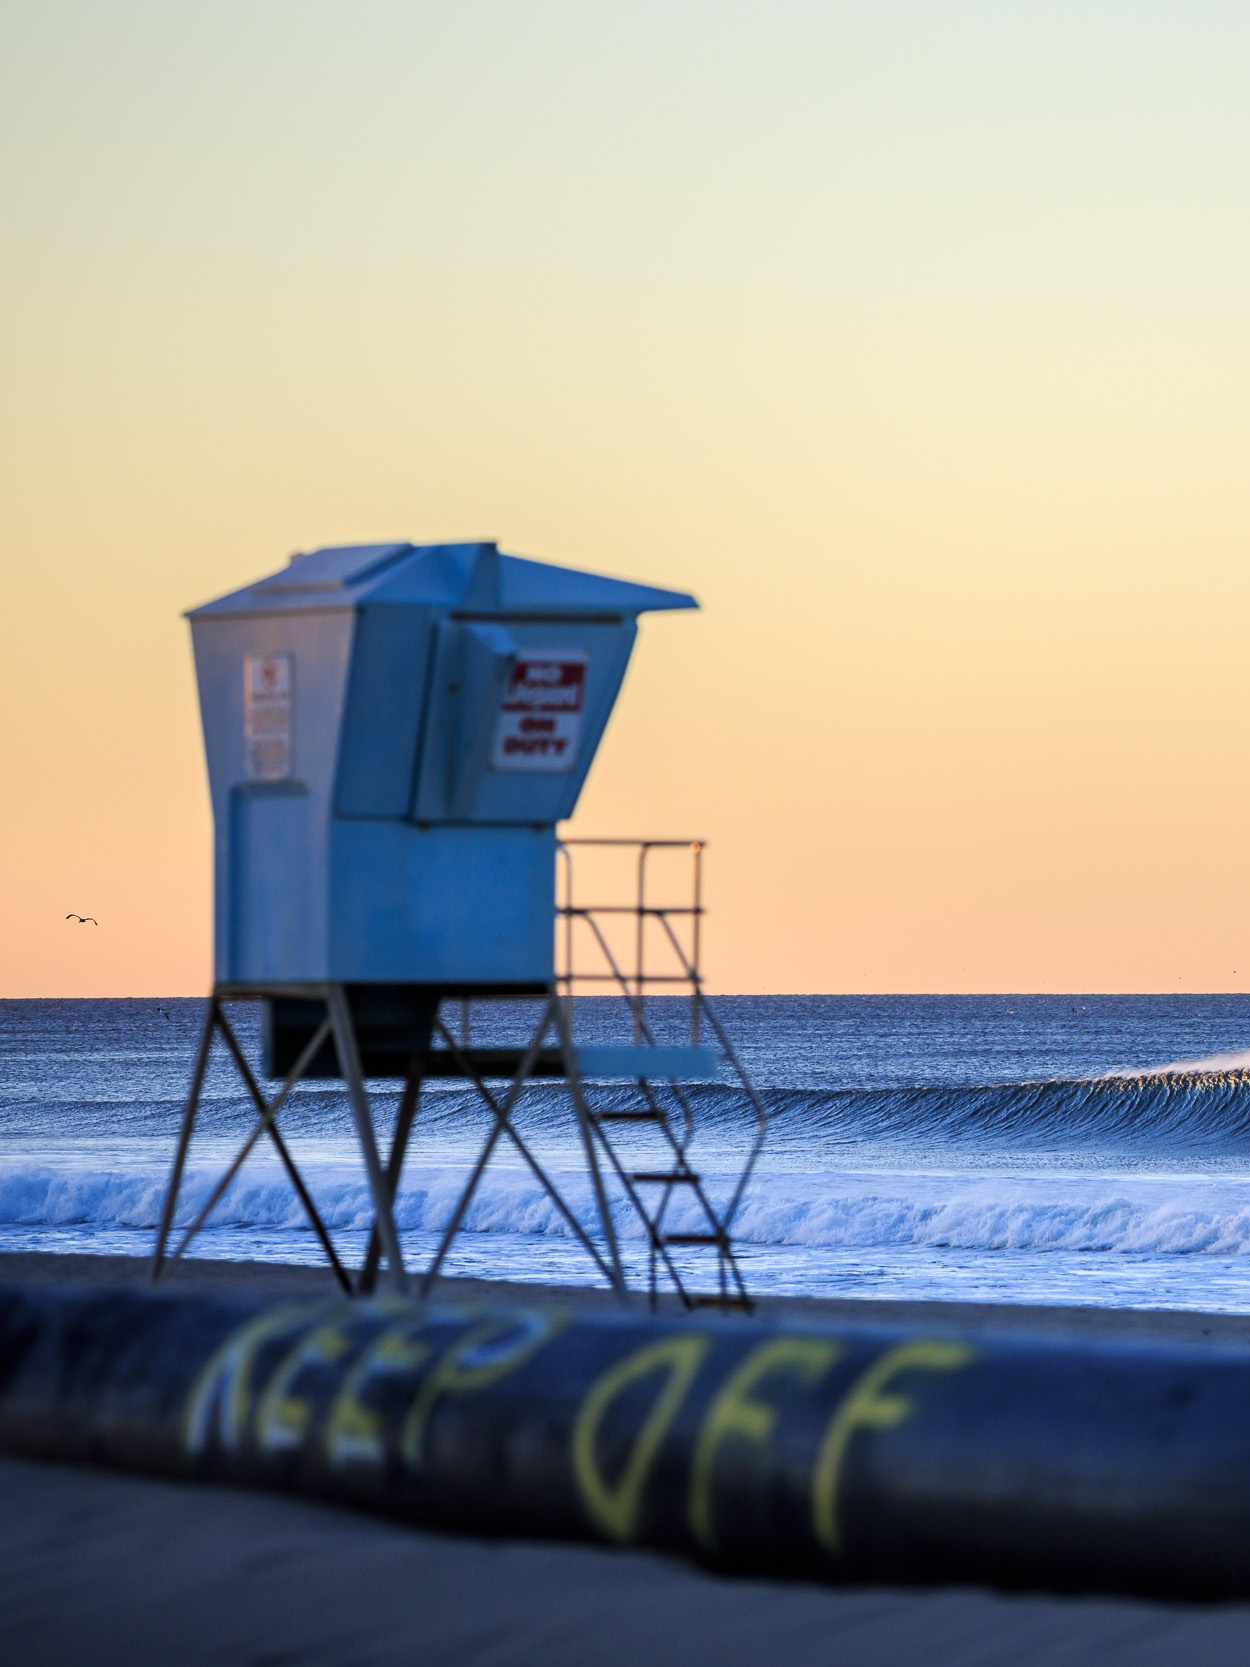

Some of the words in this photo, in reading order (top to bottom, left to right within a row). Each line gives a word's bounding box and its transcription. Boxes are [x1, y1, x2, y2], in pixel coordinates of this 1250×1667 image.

[518, 717, 556, 734] ON
[503, 736, 568, 756] DUTY
[573, 1334, 978, 1554] OFF
